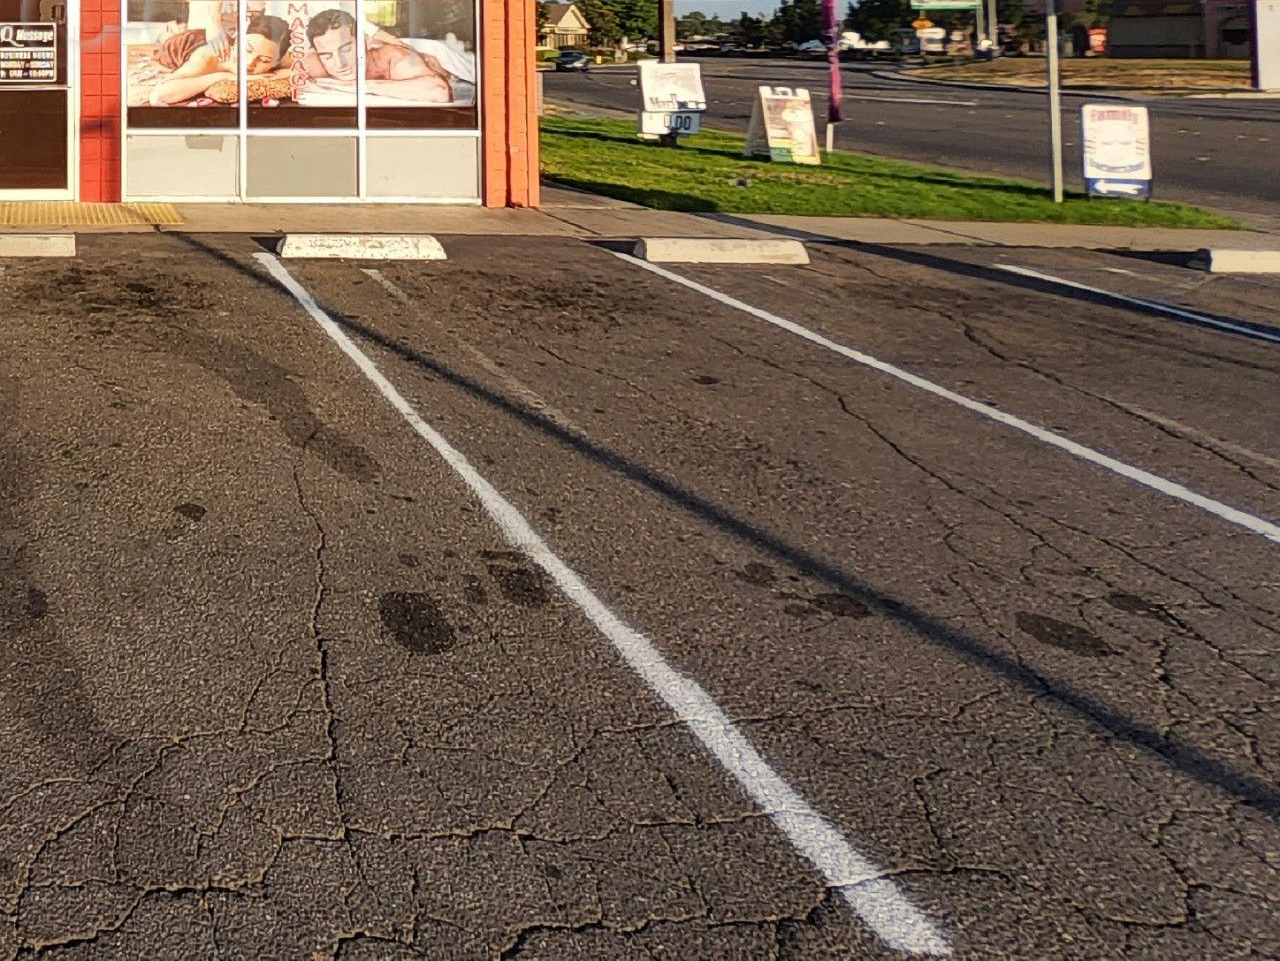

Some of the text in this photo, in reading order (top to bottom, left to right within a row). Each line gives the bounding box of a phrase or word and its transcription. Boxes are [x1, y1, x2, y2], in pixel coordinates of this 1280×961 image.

[0, 26, 54, 47] Q Massage
[287, 3, 310, 102] MASSAGE
